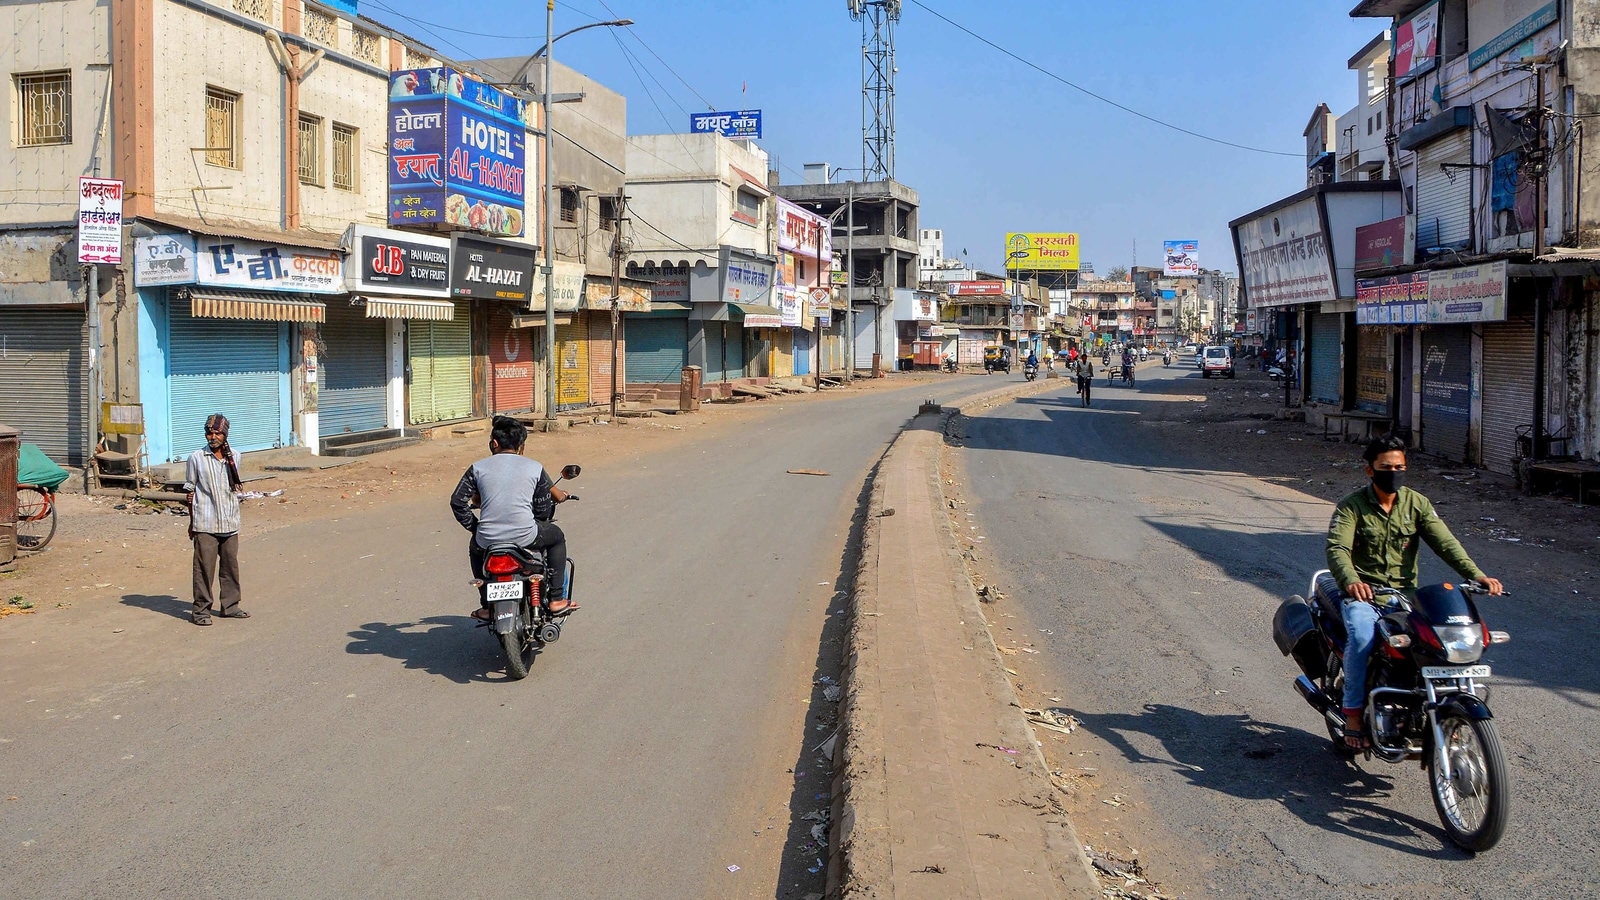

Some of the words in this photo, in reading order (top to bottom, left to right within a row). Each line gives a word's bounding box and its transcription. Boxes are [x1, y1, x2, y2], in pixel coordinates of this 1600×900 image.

[394, 108, 442, 133] होटल
[731, 115, 758, 128] लॉज
[393, 137, 415, 152] अल
[461, 115, 514, 160] HOTEL
[393, 153, 443, 187] हयात
[449, 146, 524, 195] AL-HAYAT
[1033, 234, 1075, 246] सरस्वती
[410, 249, 422, 260] PAN
[422, 250, 447, 264] MATERIAL
[469, 253, 484, 263] HOTEL
[1039, 246, 1070, 257] मिल्क
[292, 252, 341, 276] कटलरी
[410, 266, 417, 278] &
[417, 268, 429, 280] DRY
[429, 269, 446, 281] FRUITS
[465, 265, 524, 287] AL-HAYAT
[495, 364, 528, 379] vodafone
